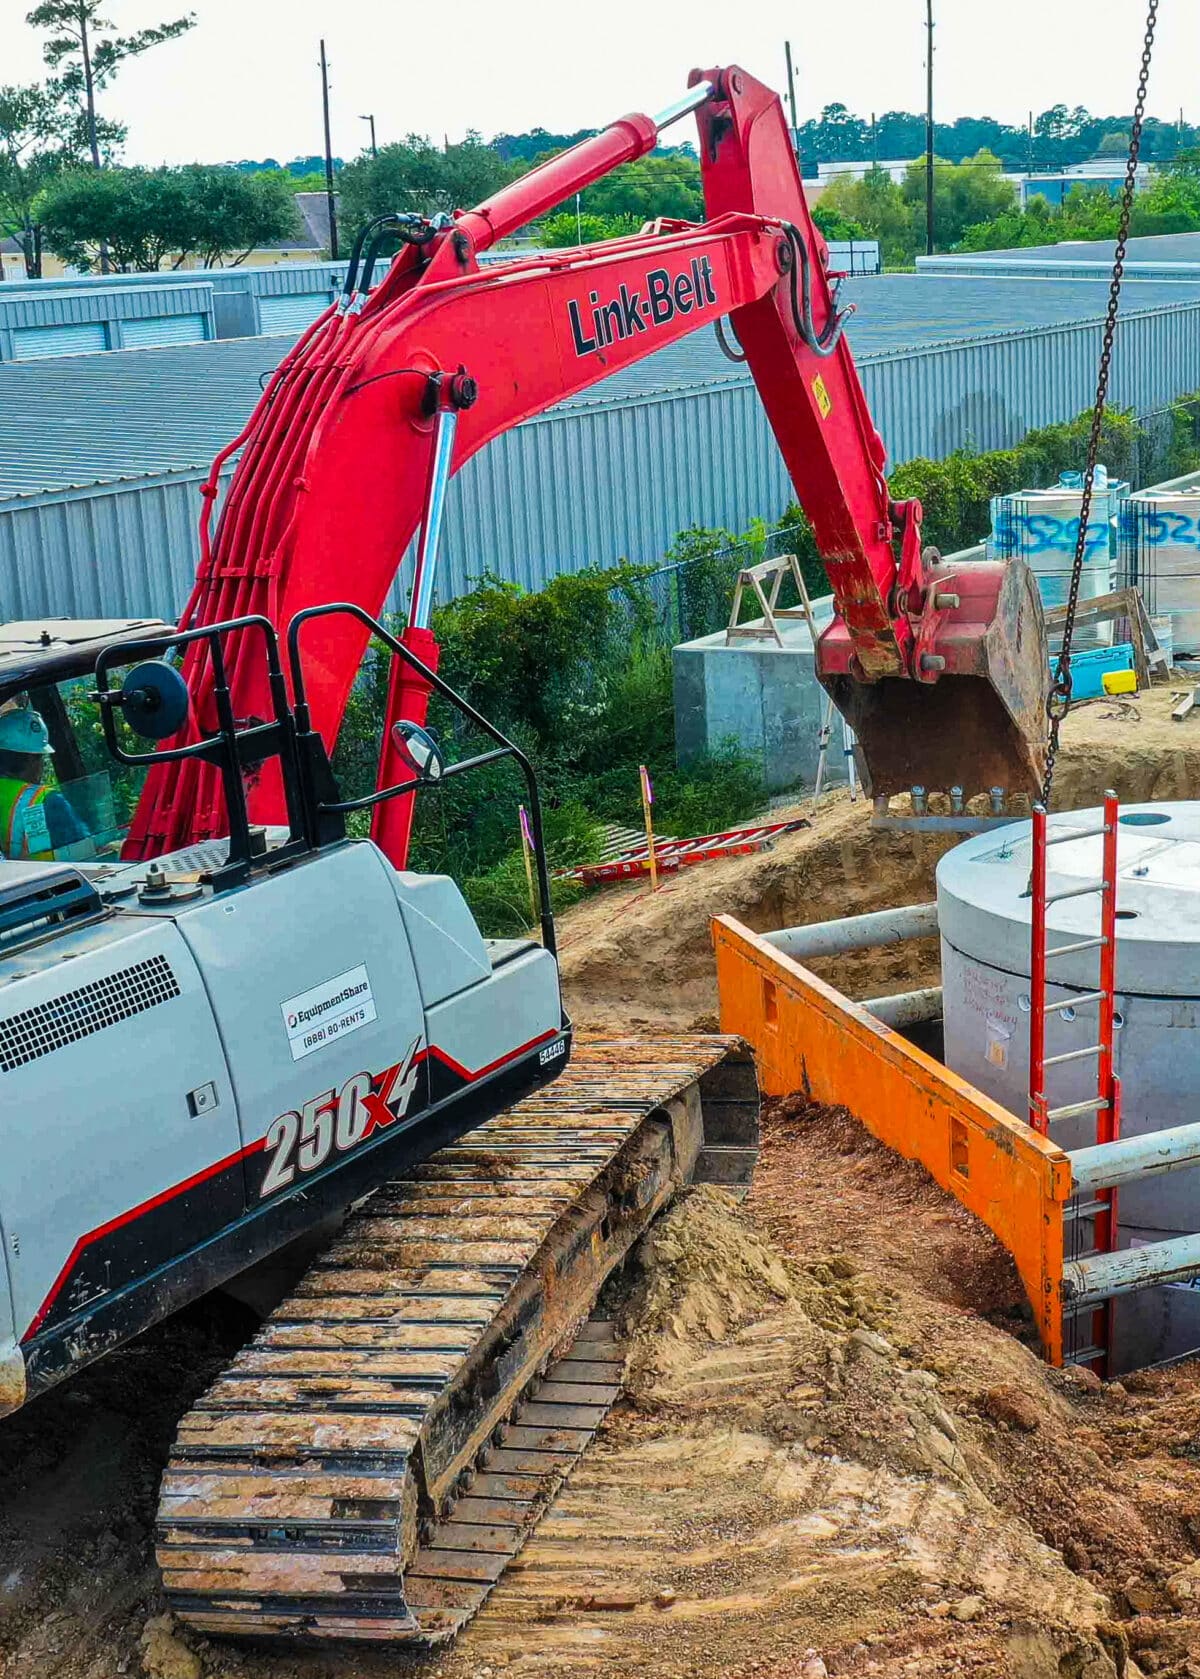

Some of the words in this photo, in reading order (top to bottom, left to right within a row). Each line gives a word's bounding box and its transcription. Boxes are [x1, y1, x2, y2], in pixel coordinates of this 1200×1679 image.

[567, 255, 717, 357] Link-Belt
[297, 982, 368, 1023] EquipmentShare
[303, 1029, 326, 1048] (888)
[327, 1009, 365, 1036] 80-RENTS
